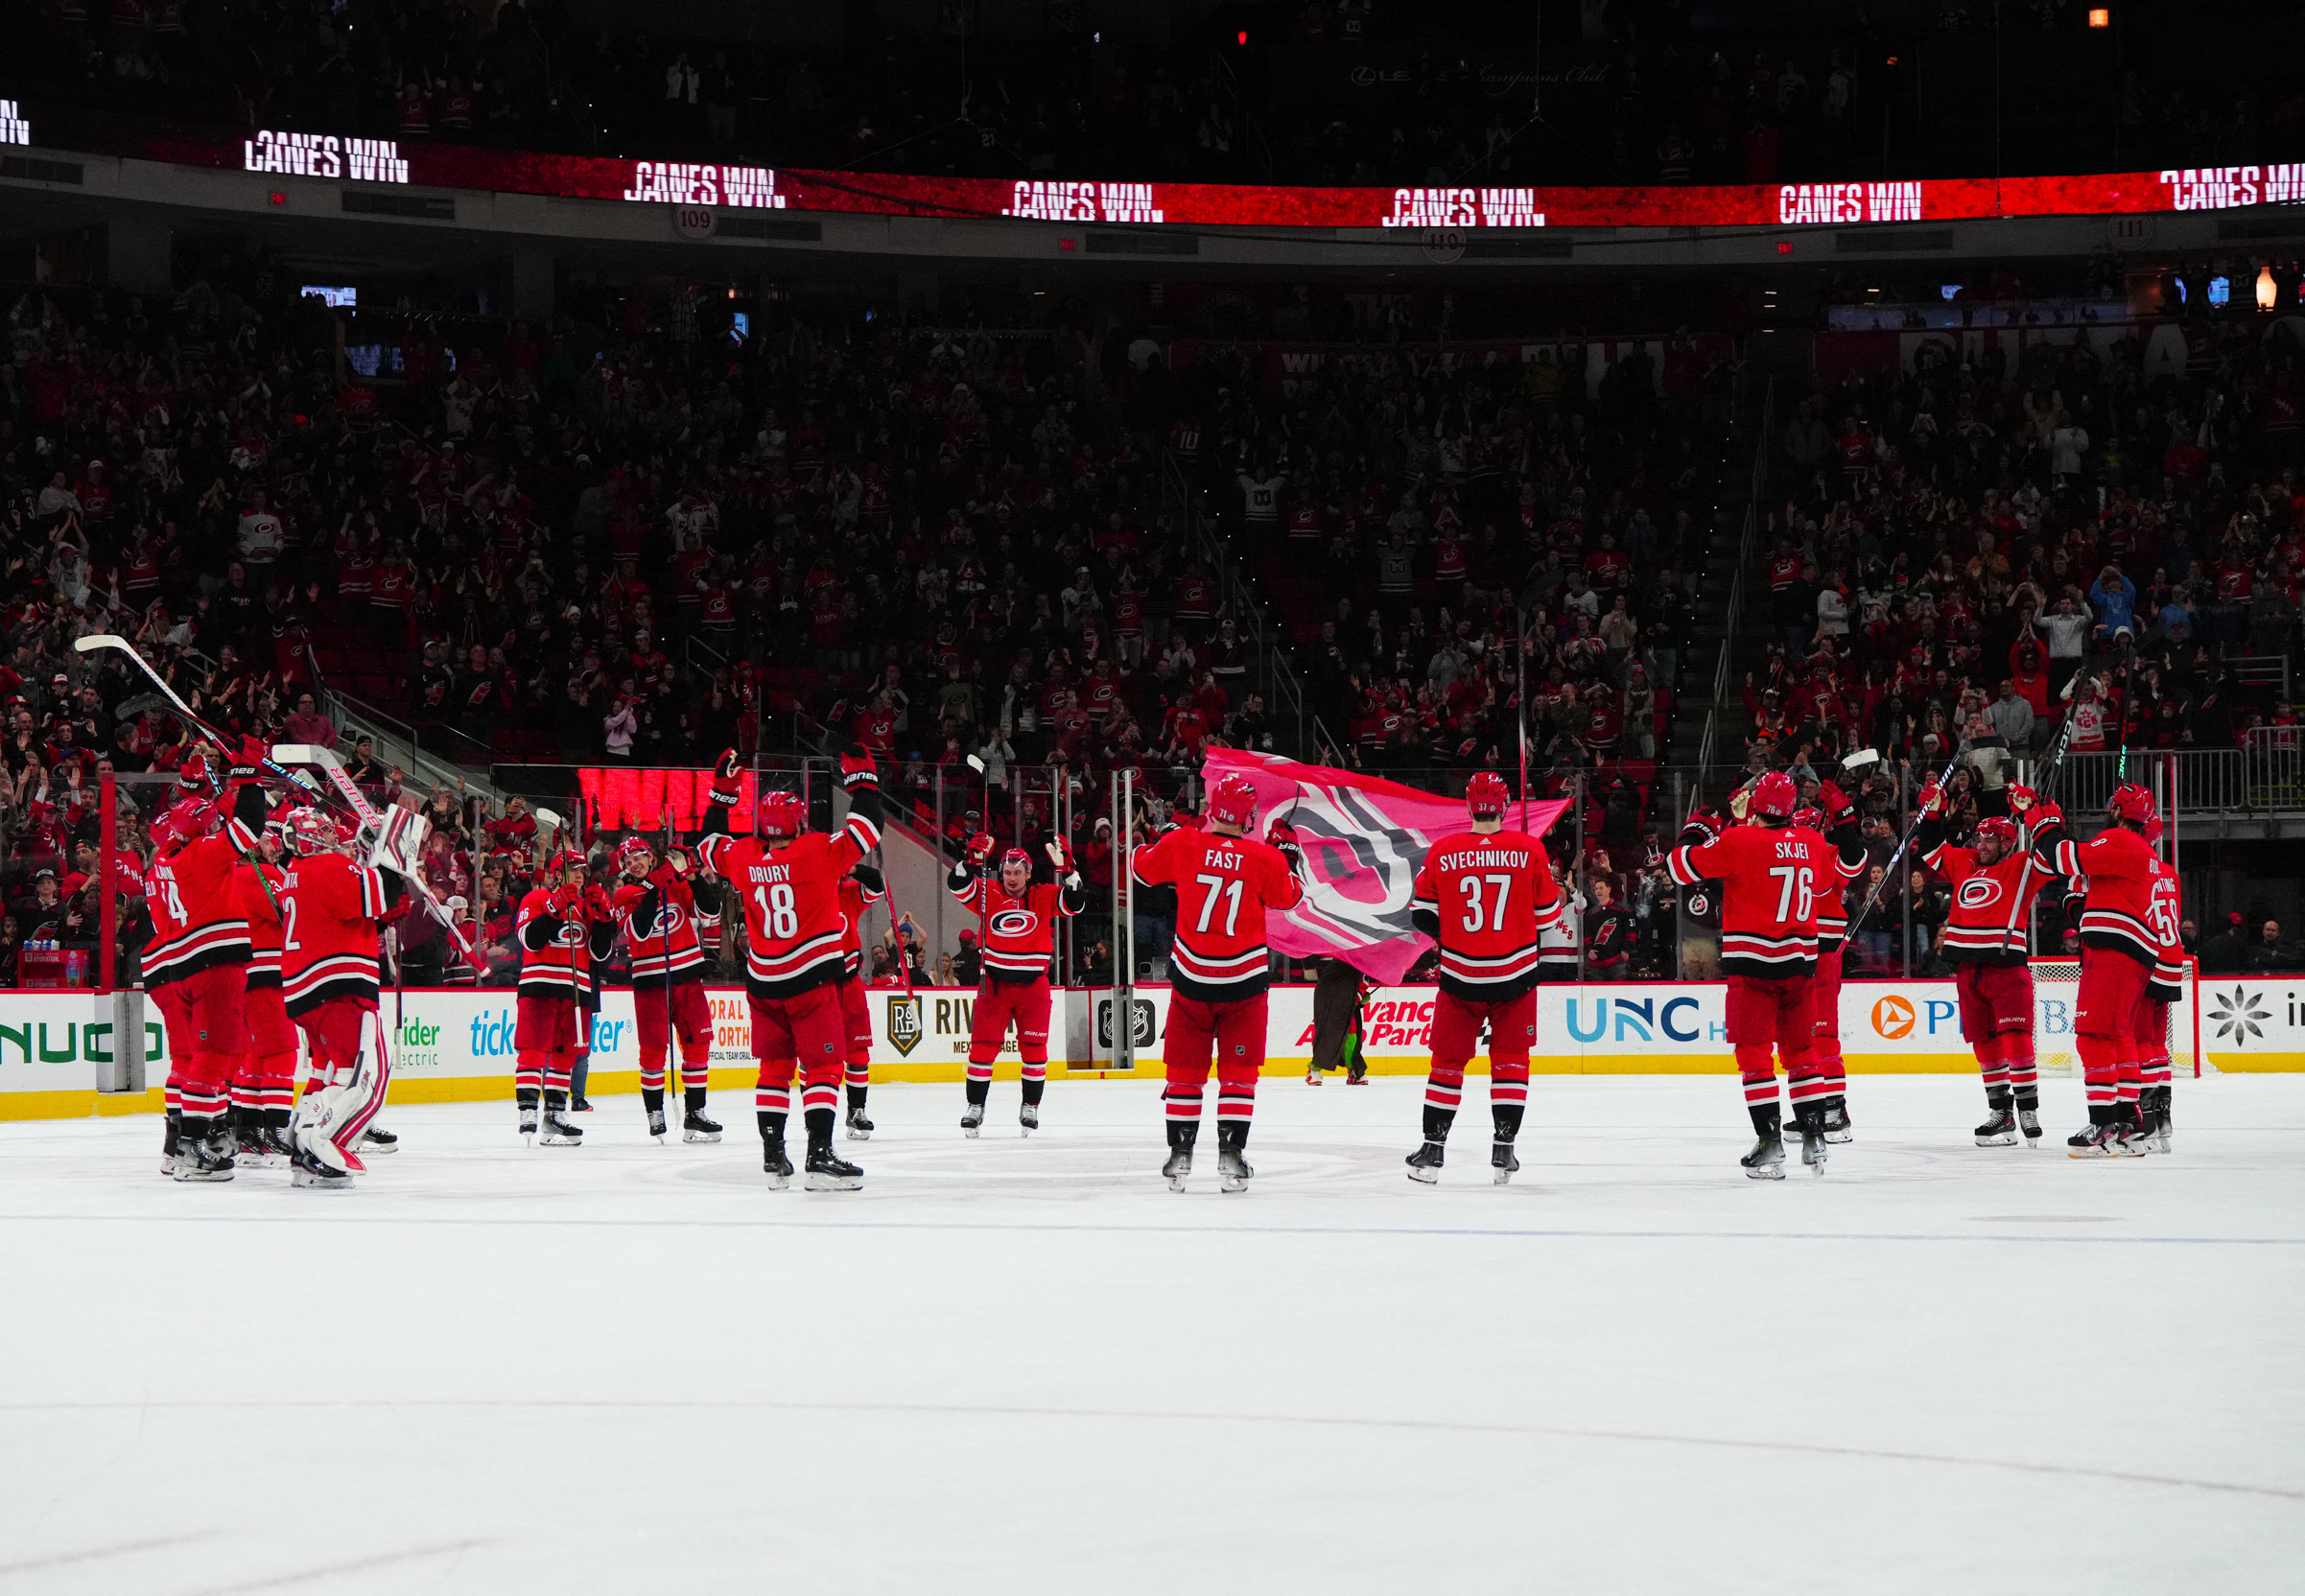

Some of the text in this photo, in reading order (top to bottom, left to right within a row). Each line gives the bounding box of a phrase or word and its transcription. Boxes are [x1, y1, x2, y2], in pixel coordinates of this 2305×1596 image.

[245, 130, 409, 183] CANES WIN
[624, 161, 786, 208] CANES WIN
[2159, 162, 2305, 211] CANES WI
[1002, 180, 1164, 223] CANES WIN
[1381, 188, 1545, 227] CANES WIN
[1778, 181, 1921, 223] CANES WIN
[680, 209, 711, 228] 109
[2117, 220, 2144, 238] 111
[1429, 232, 1459, 250] 110
[2056, 719, 2073, 766] CCM
[2118, 744, 2128, 780] SYNC
[330, 766, 382, 829] BAUER
[1478, 802, 1488, 811] 37
[1766, 804, 1776, 814] 76
[1219, 808, 1227, 818] 71
[506, 832, 531, 857] ANES
[1776, 842, 1809, 860] SKJEI
[1205, 849, 1244, 872] FAST
[1439, 850, 1530, 872] SVECHNIKOV
[748, 863, 790, 883] DRURY
[1195, 873, 1244, 937] 71
[1458, 874, 1513, 933] 37
[1769, 865, 1815, 924] 76
[754, 883, 799, 940] 18
[1555, 920, 1574, 940] NES
[709, 999, 744, 1021] ORAL
[1361, 1001, 1436, 1023] vanc
[1565, 997, 1700, 1043] UNC
[394, 1017, 440, 1046] ider
[718, 1025, 750, 1047] ORTH
[1369, 1023, 1432, 1046] Part
[708, 1051, 724, 1061] FFICIAL
[726, 1051, 738, 1061] TEAM
[1000, 1040, 1019, 1053] AGE
